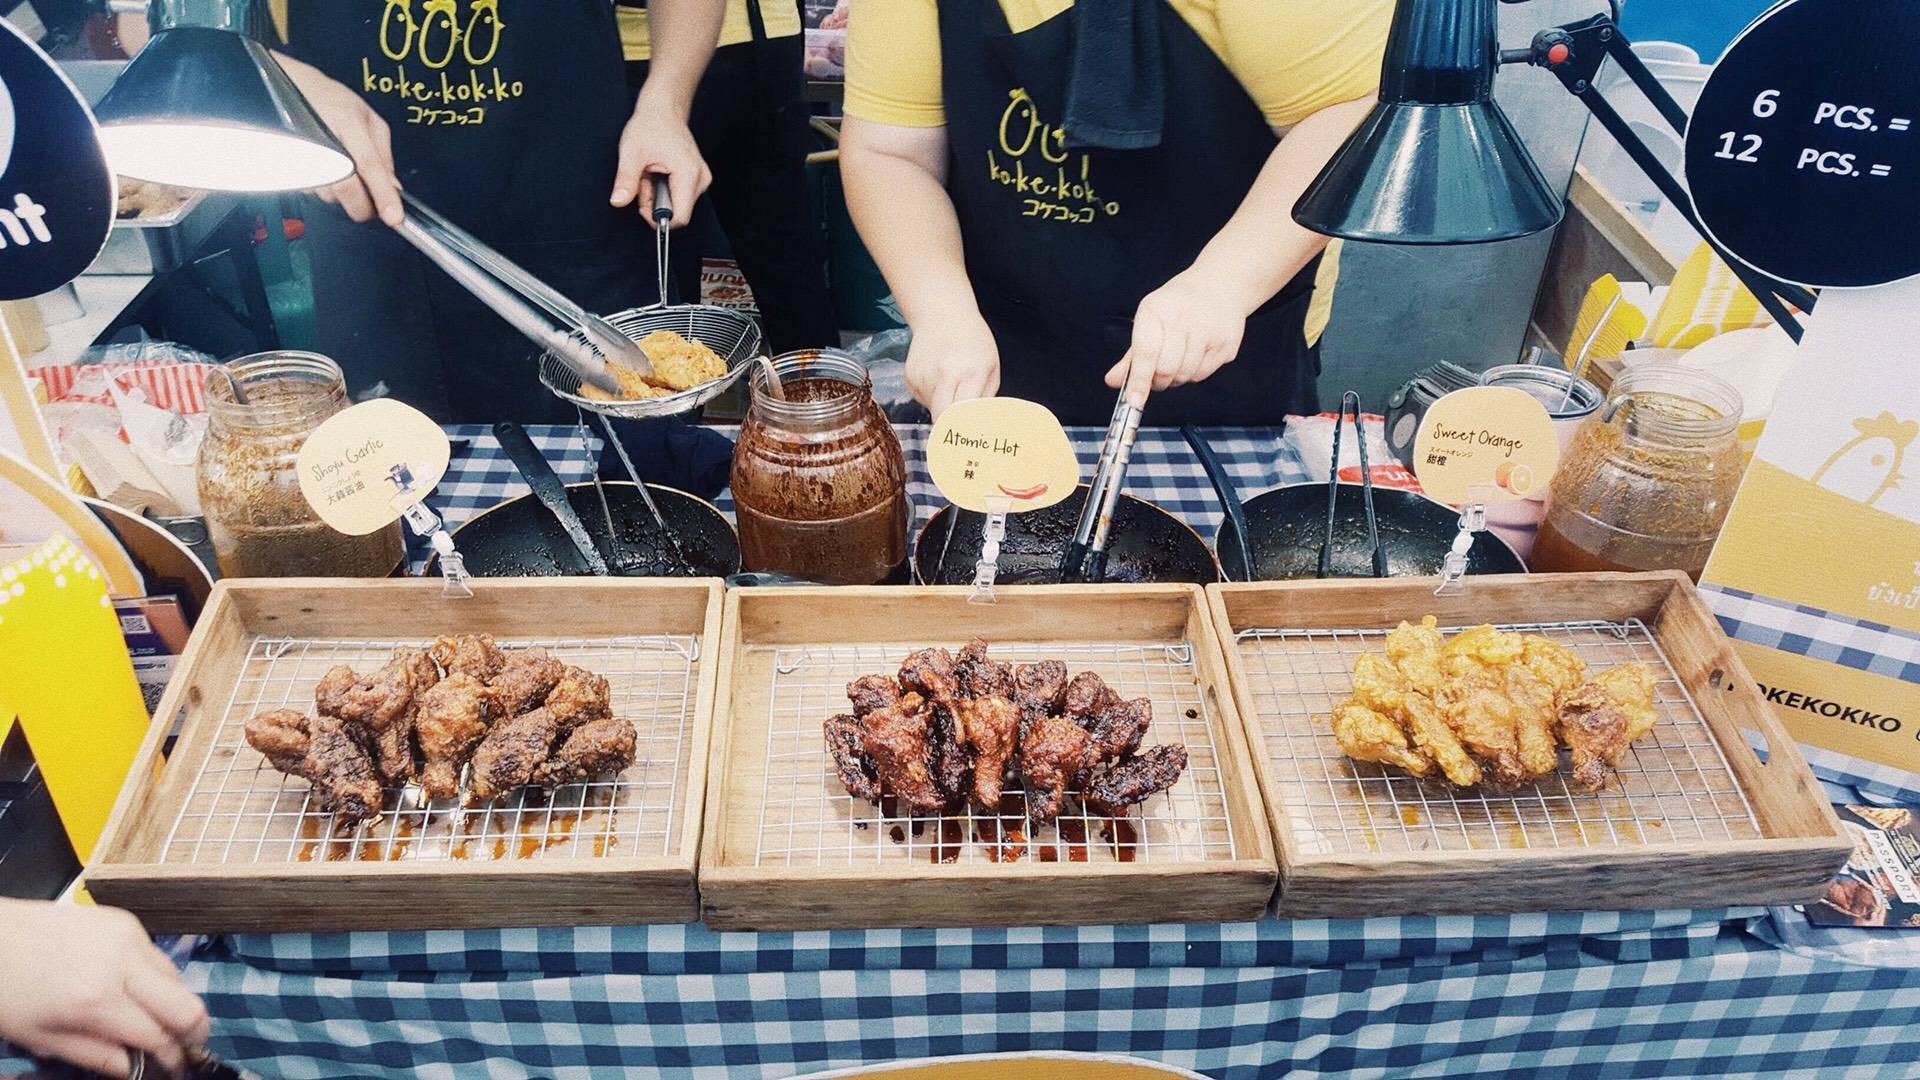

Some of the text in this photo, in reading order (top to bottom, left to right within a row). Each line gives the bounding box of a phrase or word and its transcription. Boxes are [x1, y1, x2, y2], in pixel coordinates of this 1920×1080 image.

[1752, 89, 1781, 118] 6
[1813, 102, 1879, 132] PCS.
[1714, 131, 1763, 163] 12
[1797, 148, 1860, 177] PCS.
[311, 438, 384, 482] Shoyu Garlic
[943, 429, 1020, 457] Atomic Hot
[1433, 422, 1523, 458] Sweet Orange
[1757, 682, 1902, 733] KEKOKKO
[1870, 832, 1918, 901] PASSPORT
